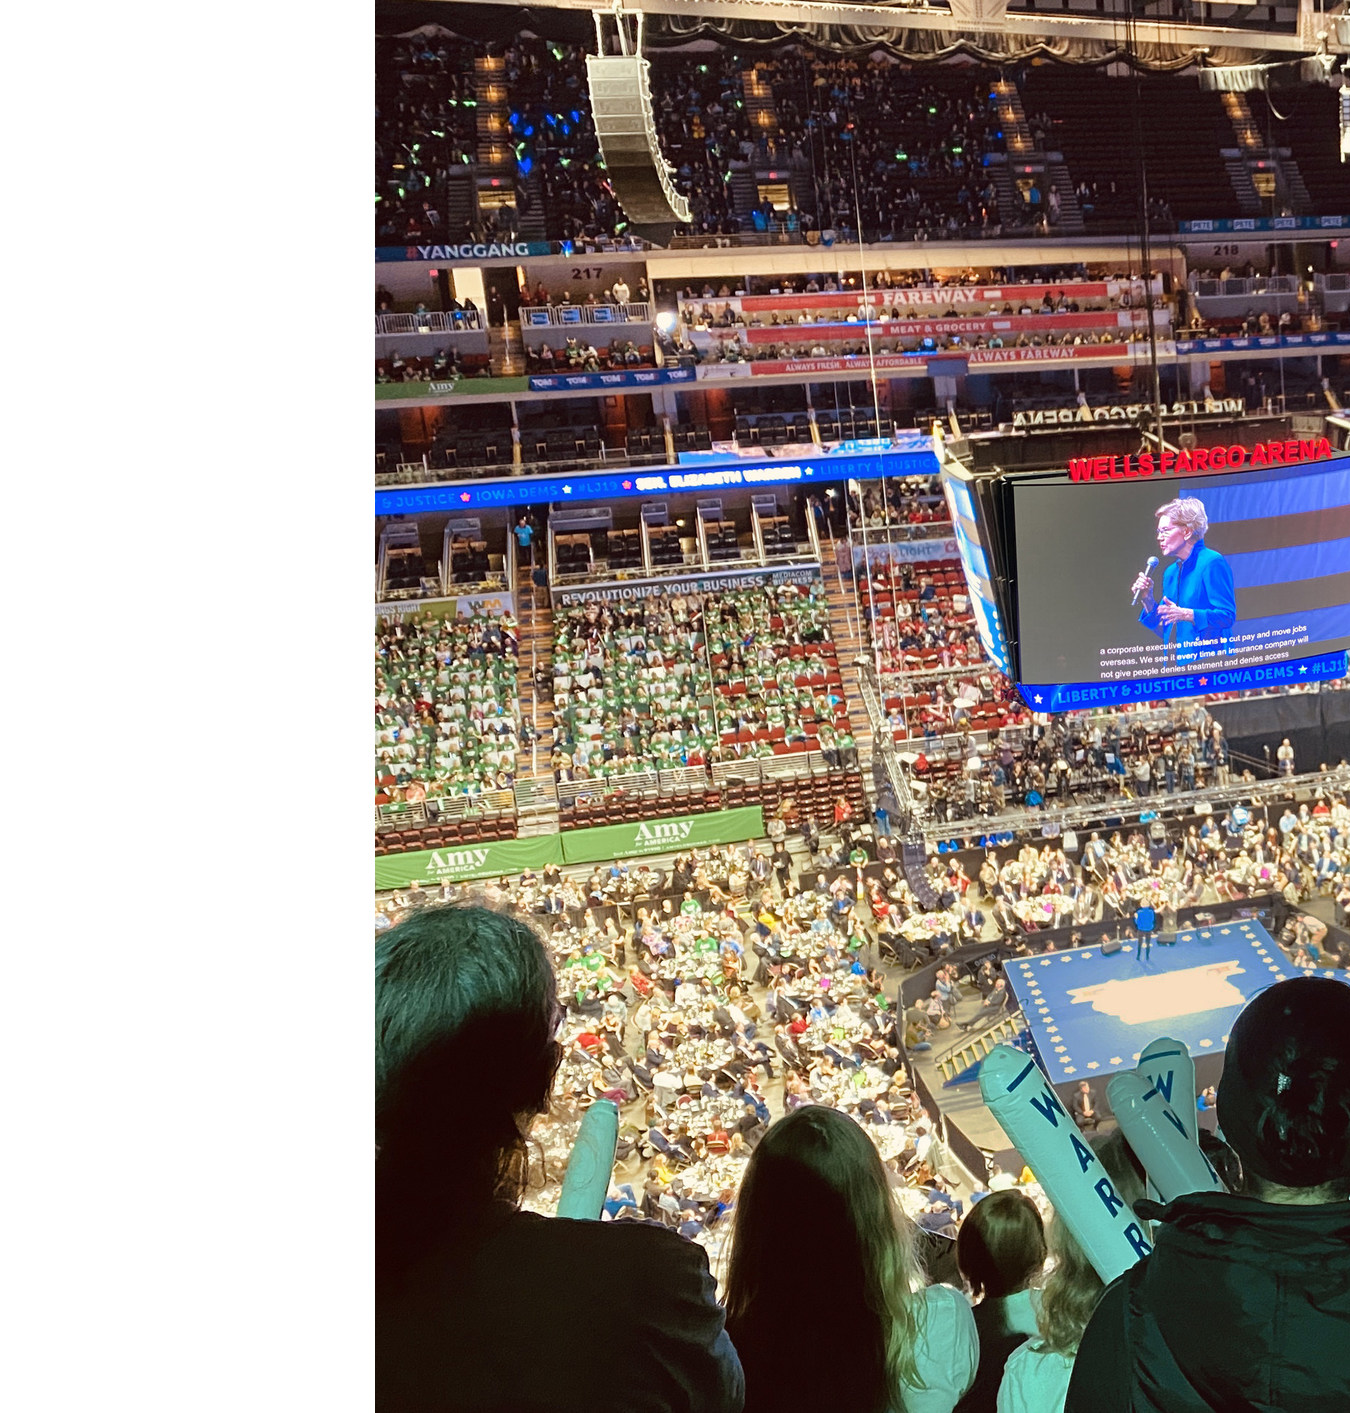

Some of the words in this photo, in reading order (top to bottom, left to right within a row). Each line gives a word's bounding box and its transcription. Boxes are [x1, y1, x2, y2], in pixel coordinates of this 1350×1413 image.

[406, 242, 529, 260] #YANGGANG
[1214, 245, 1239, 256] 218
[571, 267, 603, 280] 217
[883, 289, 977, 305] FAREWAY
[890, 325, 921, 334] MEAT
[924, 324, 933, 333] &
[935, 322, 986, 333] GROCERY
[968, 350, 1016, 362] ALWAYS
[785, 363, 816, 372] ALWAYS
[845, 360, 876, 368] ALWAY
[1068, 452, 1155, 482] WELLS
[1159, 444, 1246, 475] FARGO
[1249, 437, 1333, 466] ARENA
[396, 493, 457, 507] JUSTICE
[476, 488, 515, 502] IOWA
[519, 485, 559, 499] DEMS
[578, 480, 618, 493] #LJ19
[820, 462, 872, 476] LIBERTY
[900, 545, 932, 558] LIGHT
[772, 576, 813, 586] BUNESS
[561, 584, 661, 606] REVOLUTIONIZE
[663, 580, 699, 596] YOUR
[703, 575, 764, 592] BUSINESS
[1099, 647, 1106, 655] a
[1106, 644, 1144, 656] corporate
[1145, 641, 1182, 651] executive
[1183, 637, 1219, 648] threatens
[1229, 634, 1241, 643] cut
[1241, 633, 1256, 643] pay
[1256, 630, 1271, 639] and
[1271, 627, 1291, 637] move
[1291, 623, 1307, 635] jobs
[1099, 657, 1138, 667] overseas.
[1139, 656, 1153, 664] We
[1154, 654, 1169, 662] see
[1169, 653, 1176, 661] it
[1176, 651, 1197, 661] every
[1199, 649, 1215, 658] time
[1217, 648, 1227, 656] an
[1228, 643, 1264, 655] insurance
[1264, 639, 1297, 651] company
[1297, 635, 1310, 643] will
[1100, 670, 1113, 679] not
[1114, 668, 1131, 679] give
[1132, 666, 1159, 678] people
[1160, 664, 1186, 674] denies
[1187, 660, 1223, 671] treatment
[1224, 657, 1239, 667] and
[1239, 654, 1264, 665] denies
[1264, 651, 1289, 661] access
[1057, 685, 1119, 705] LIBERTY
[1120, 684, 1132, 696] &
[1133, 678, 1196, 696] JUSTICE
[1212, 671, 1253, 687] IOWA
[1254, 665, 1295, 682] DEMS
[634, 820, 695, 842] Amy
[644, 836, 681, 847] AMERICA
[425, 848, 491, 870] Amy
[436, 865, 475, 875] AMERICA
